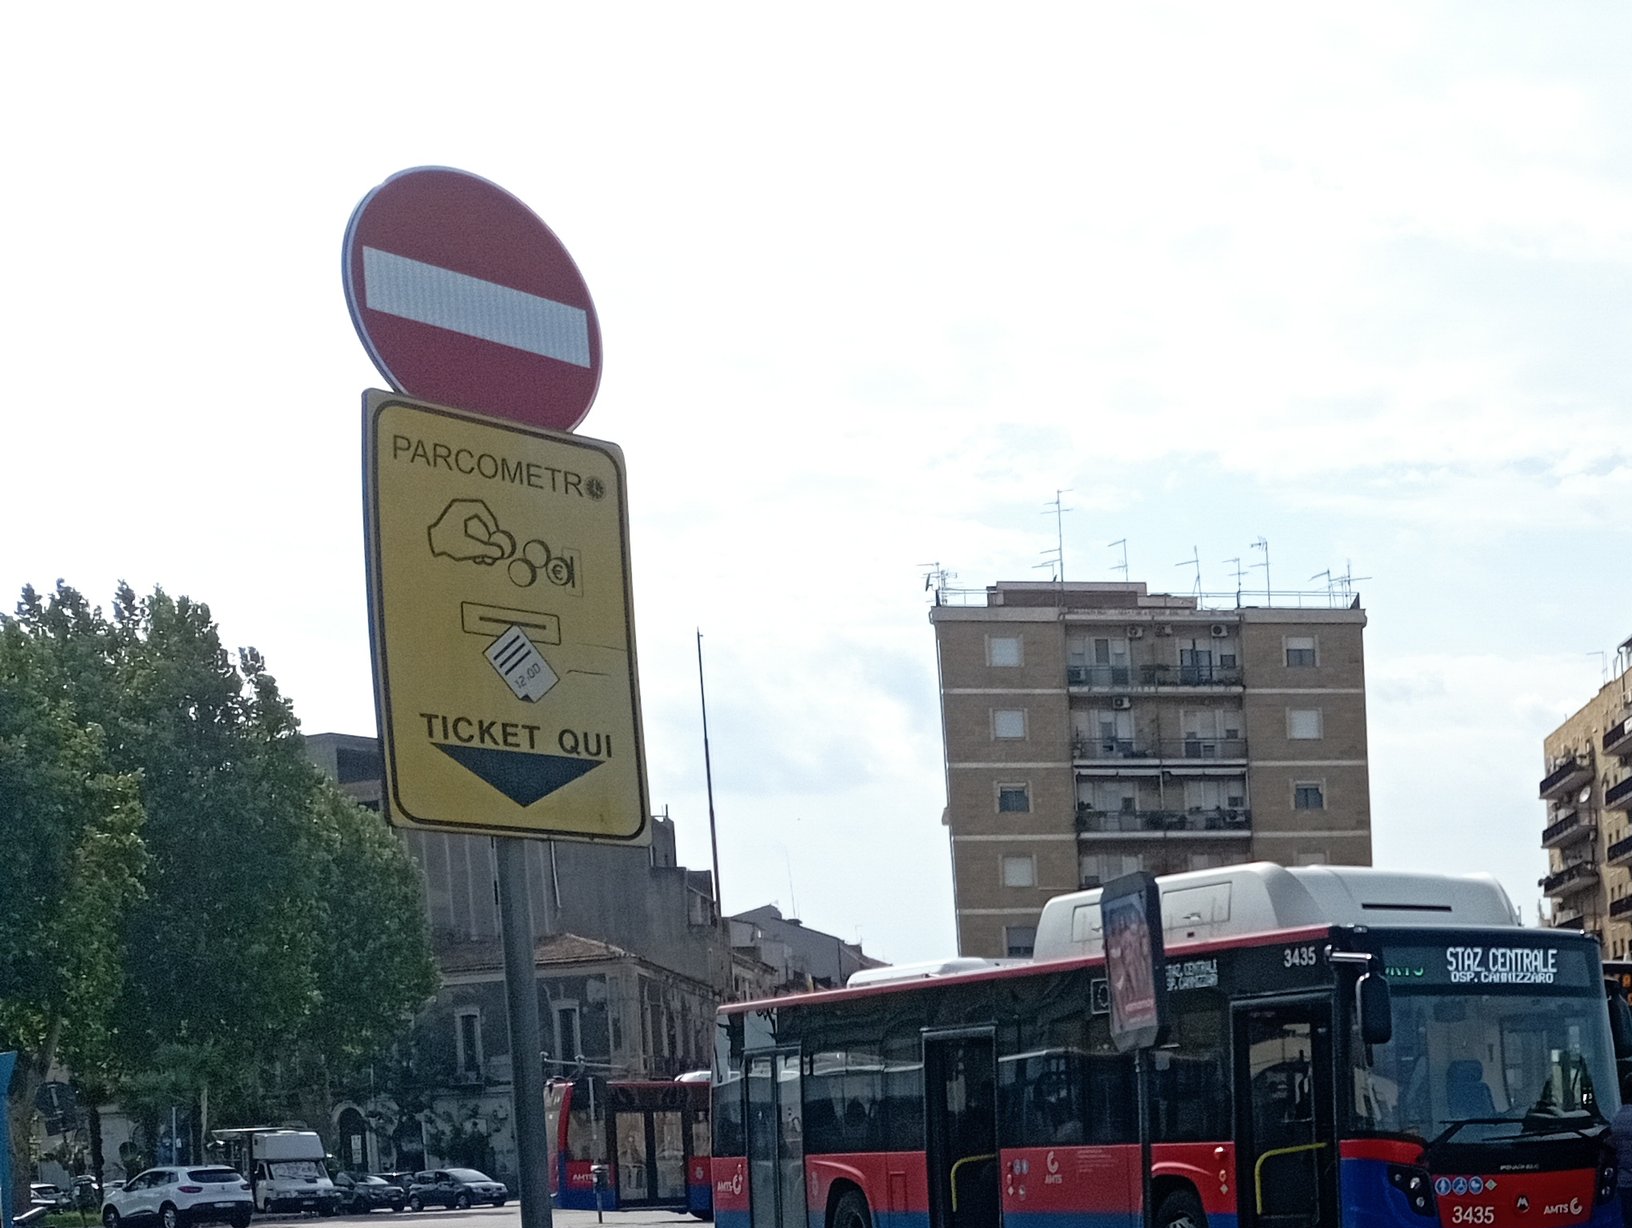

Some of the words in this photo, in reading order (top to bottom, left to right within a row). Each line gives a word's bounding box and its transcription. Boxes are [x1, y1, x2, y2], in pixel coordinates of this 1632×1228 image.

[419, 712, 541, 750] TICKET
[558, 728, 612, 758] QUI
[1284, 946, 1317, 967] 3435
[1489, 948, 1558, 973] CENTRALE
[1451, 971, 1478, 983] OSP.
[1481, 972, 1554, 983] CANNIZZARO
[1452, 1206, 1494, 1224] 3435
[1543, 1203, 1568, 1215] AMTS
